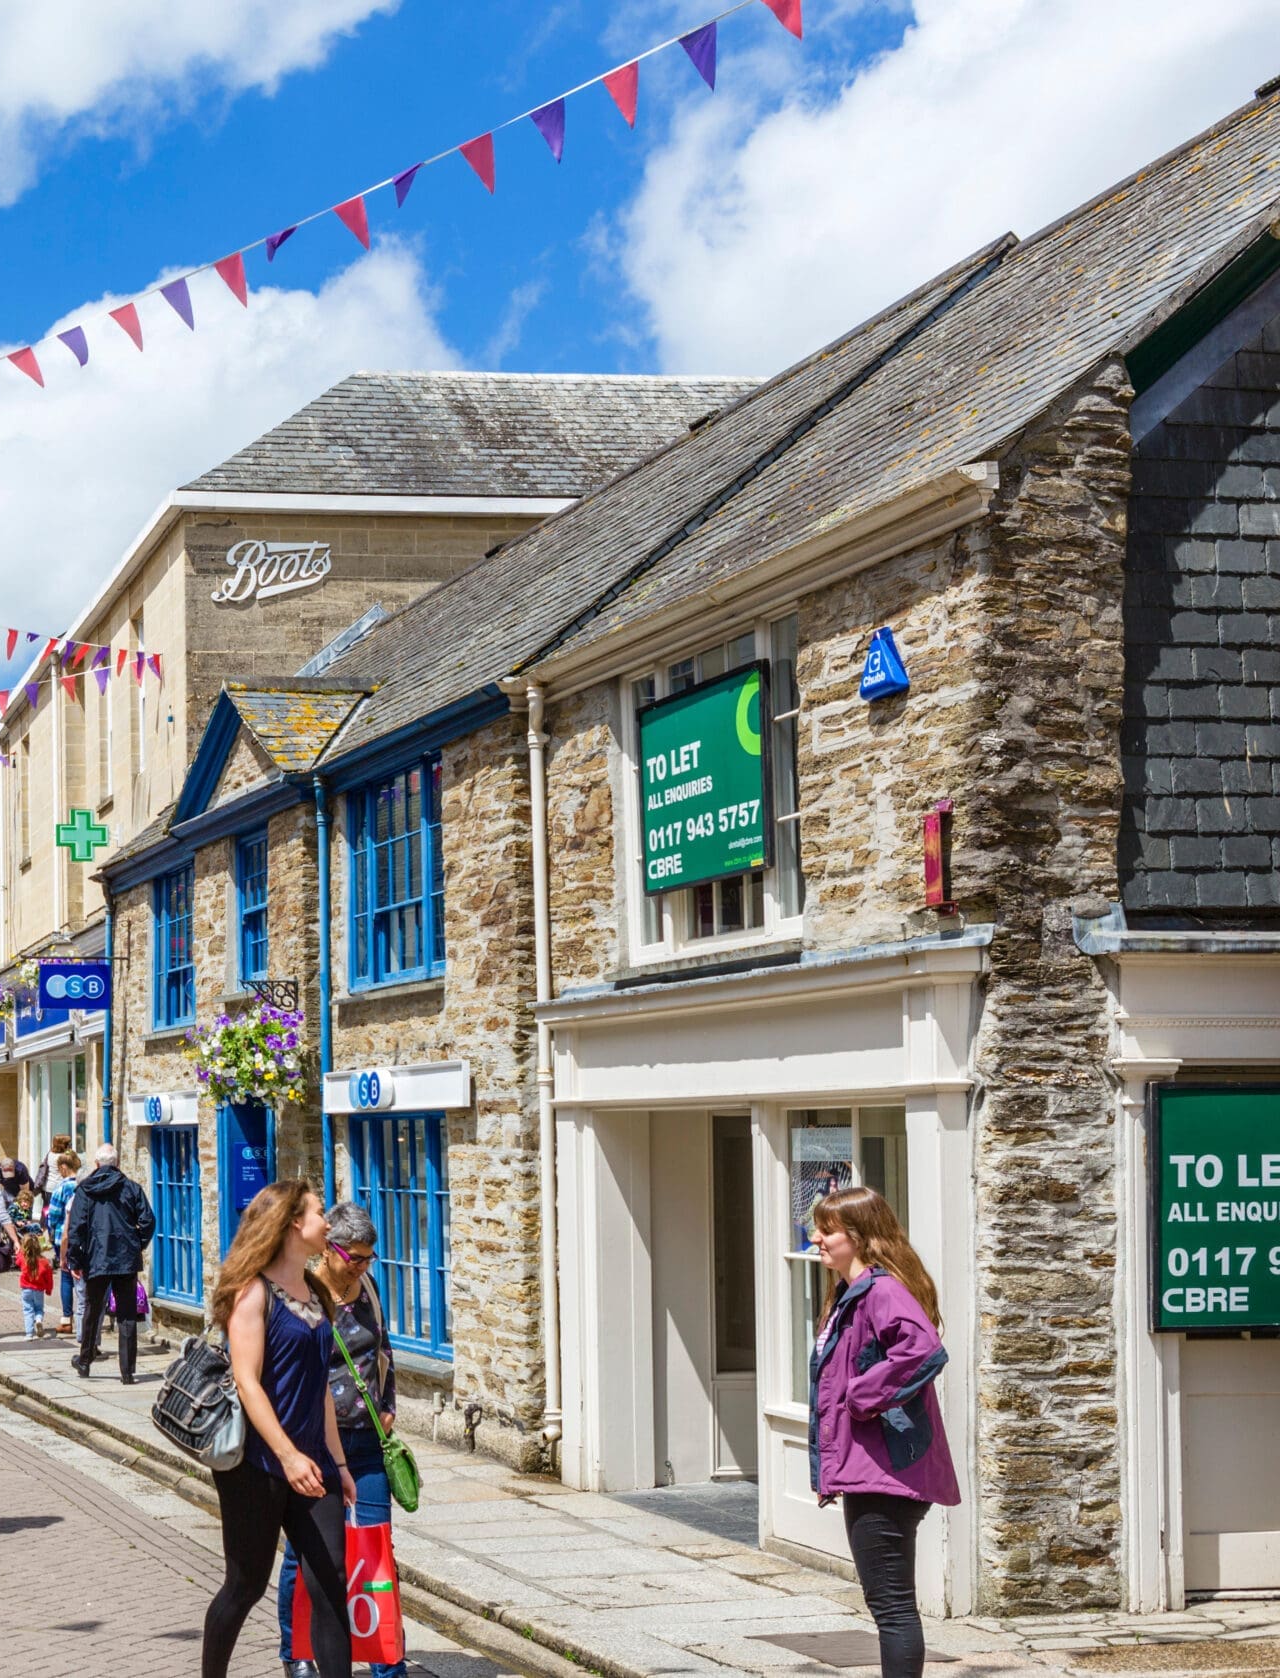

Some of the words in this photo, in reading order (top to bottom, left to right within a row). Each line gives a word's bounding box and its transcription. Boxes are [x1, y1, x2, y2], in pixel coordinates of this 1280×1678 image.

[210, 540, 331, 601] Boots
[863, 670, 886, 687] Chubb
[646, 754, 667, 783] TO
[671, 740, 701, 776] LET
[648, 792, 664, 811] ALL
[664, 775, 713, 805] ENQUIRIES
[649, 821, 683, 852] 0117
[686, 812, 715, 841] 943
[718, 799, 760, 832] 5757
[648, 853, 683, 880] CBRE
[50, 978, 101, 996] TSB
[1169, 1154, 1223, 1188] TO
[1168, 1202, 1209, 1222] ALL
[1216, 1201, 1280, 1222] ENQU
[1168, 1247, 1257, 1277] 0117
[1162, 1286, 1249, 1313] CBRE
